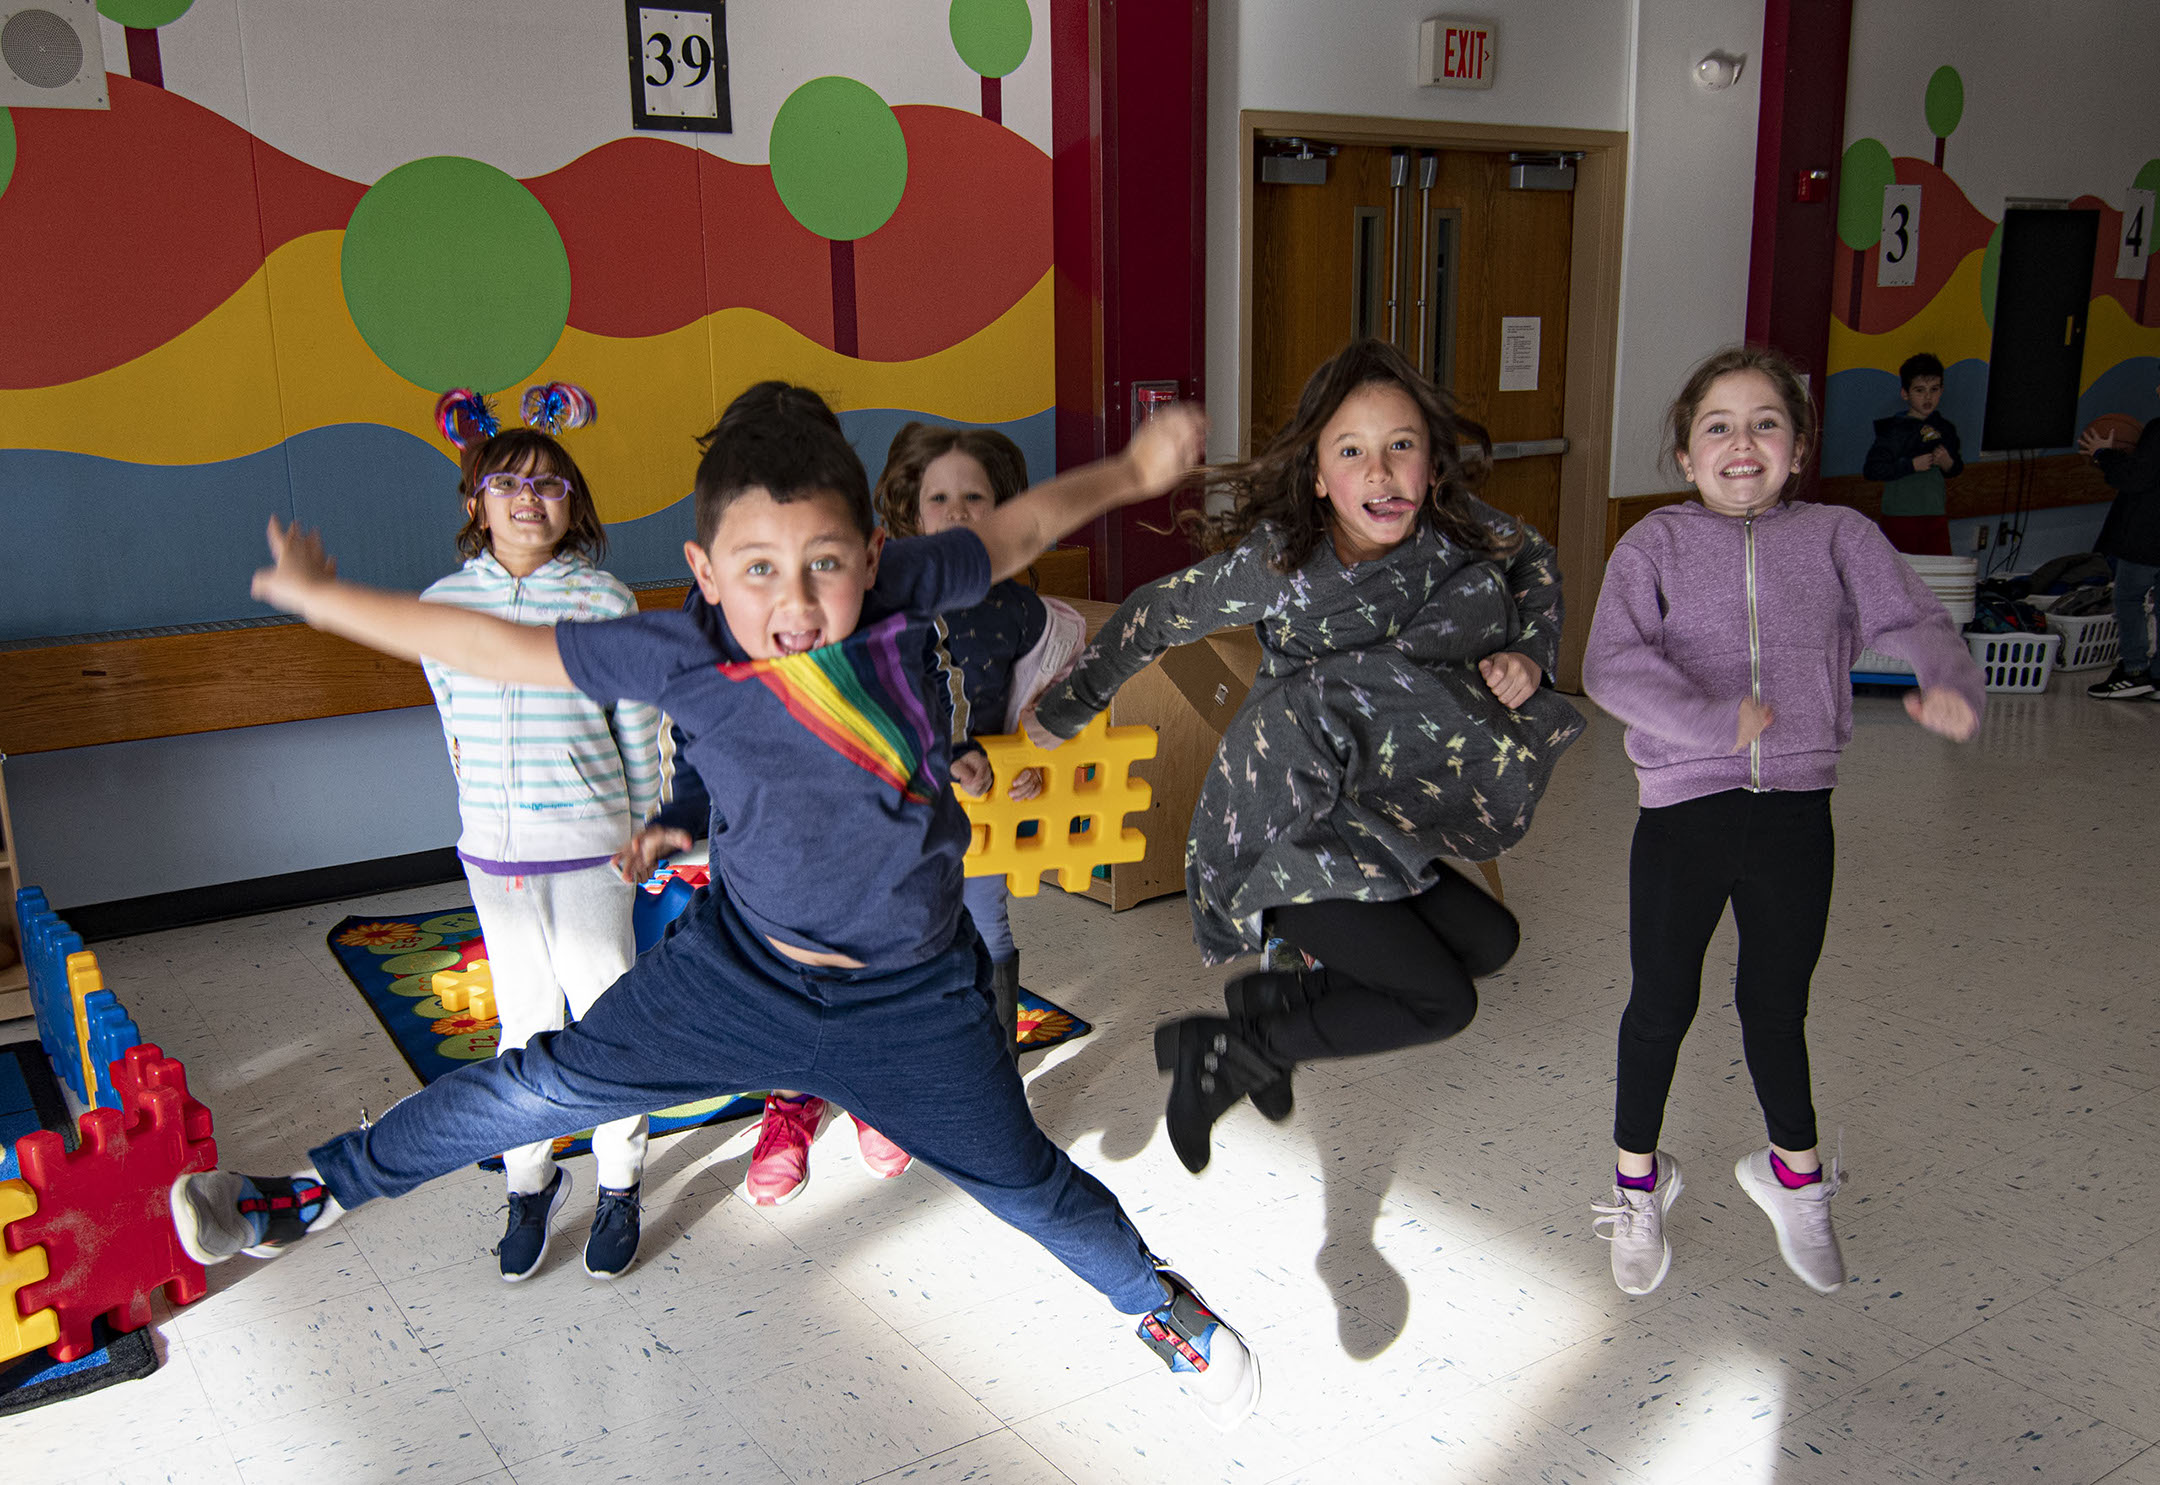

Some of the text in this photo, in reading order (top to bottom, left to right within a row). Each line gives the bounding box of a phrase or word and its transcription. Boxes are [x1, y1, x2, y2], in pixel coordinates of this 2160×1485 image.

[646, 33, 711, 87] 39
[1444, 29, 1487, 79] EXIT
[1886, 204, 1909, 263] 3
[2125, 206, 2143, 257] 4
